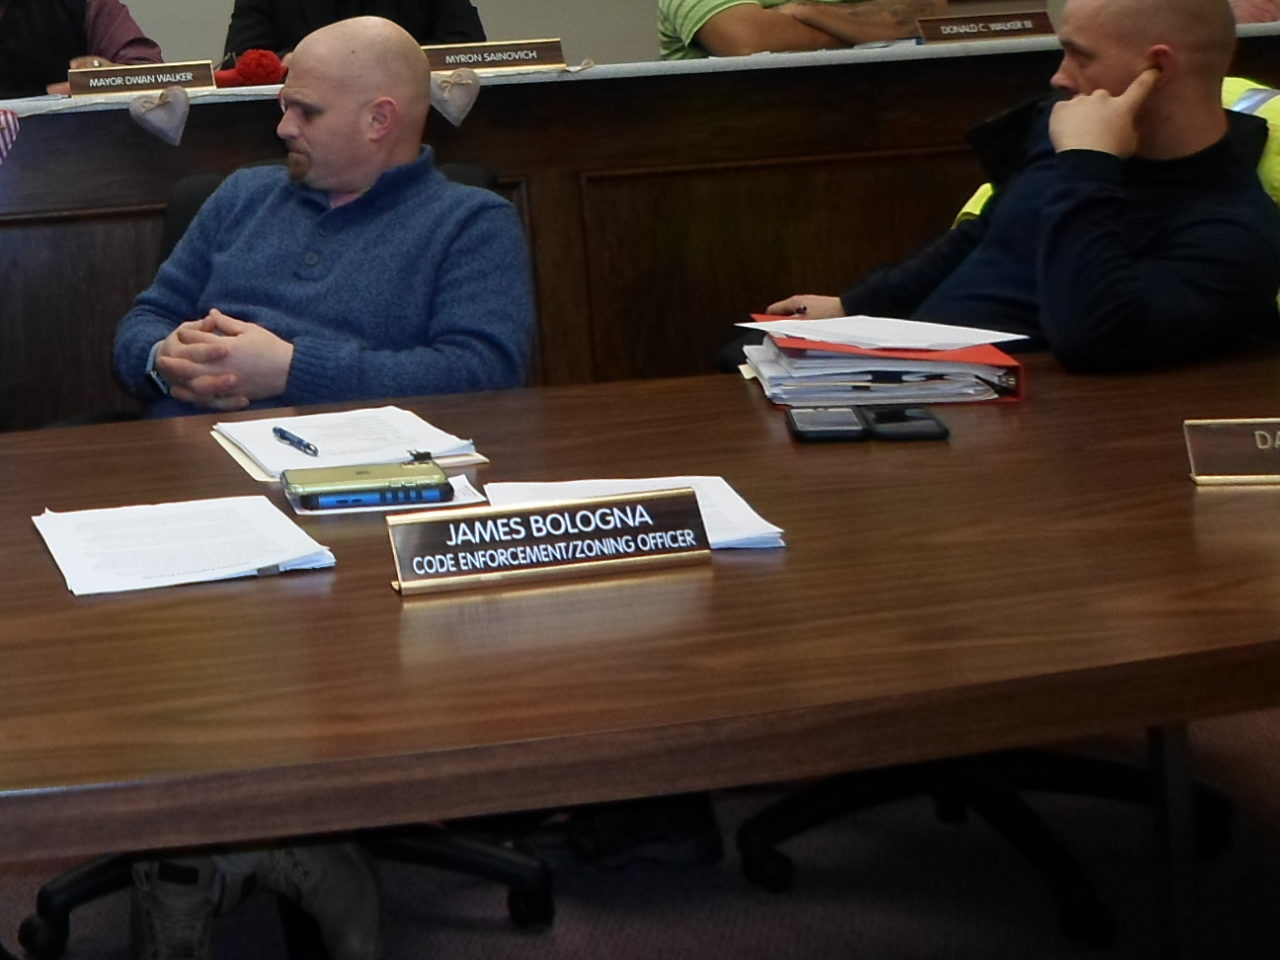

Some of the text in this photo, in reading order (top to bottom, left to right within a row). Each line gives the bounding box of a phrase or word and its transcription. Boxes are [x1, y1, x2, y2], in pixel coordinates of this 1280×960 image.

[941, 24, 978, 34] DONALD
[445, 50, 537, 64] MYRON SAINOVICH
[89, 72, 193, 87] MAYOR DWAN WALKER
[446, 504, 653, 546] JAMES BOLOGNA
[412, 529, 696, 575] CODE ENFORCEMENT/ZONING OFFICER
